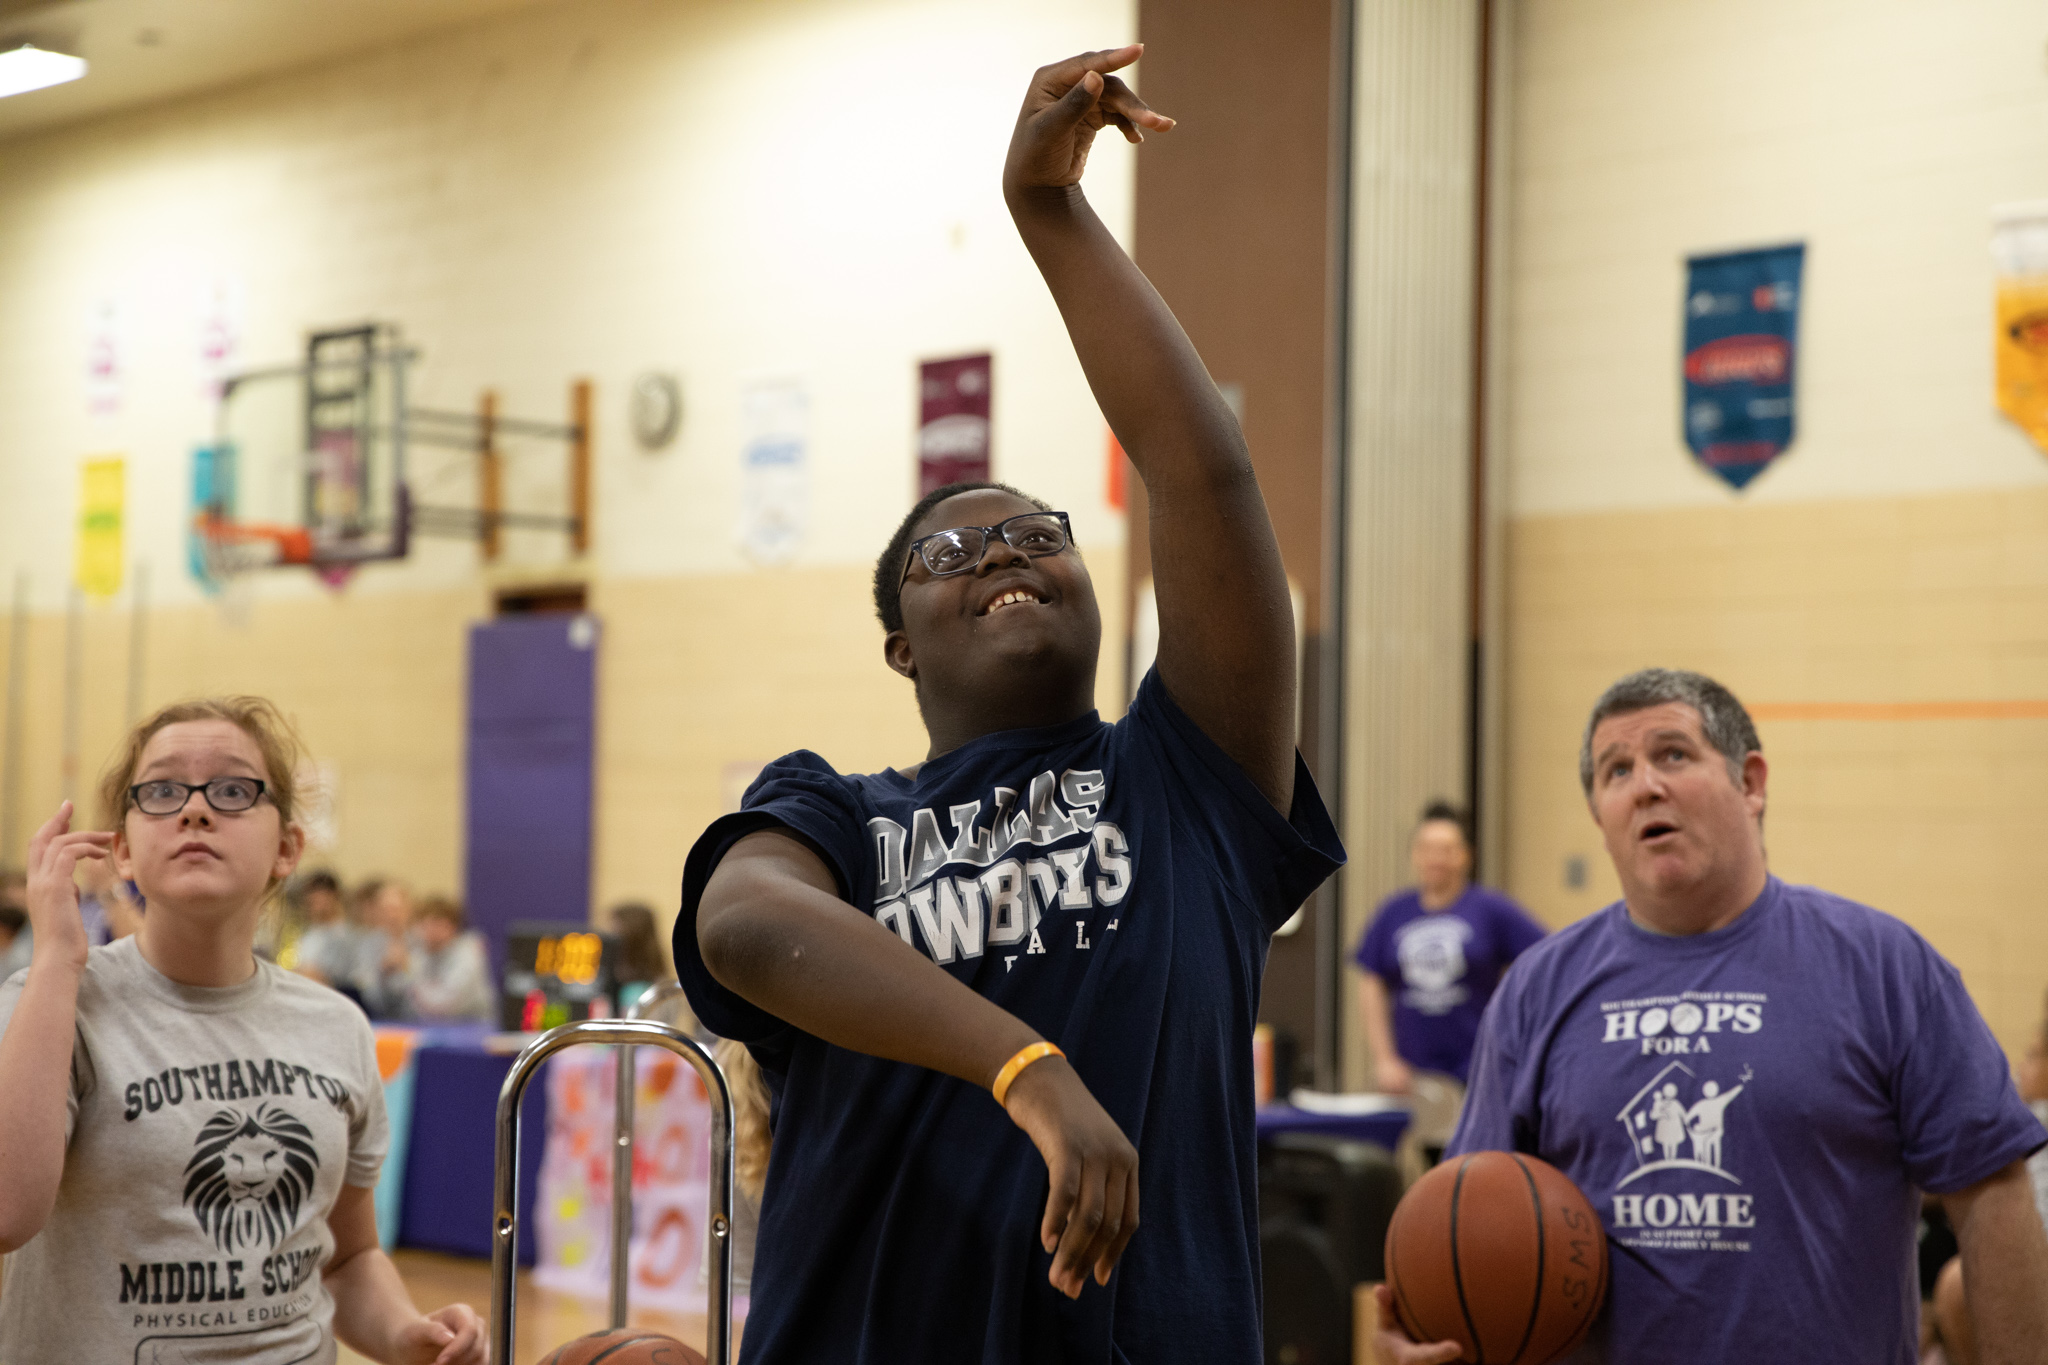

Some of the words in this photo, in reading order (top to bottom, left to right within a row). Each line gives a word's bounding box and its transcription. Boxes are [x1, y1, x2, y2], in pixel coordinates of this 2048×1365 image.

[867, 768, 1106, 904] DALLAS
[873, 821, 1133, 966] WBOYS
[1602, 1003, 1763, 1043] HOOPS
[1640, 1036, 1690, 1056] FOR
[1693, 1035, 1711, 1053] A
[124, 1058, 350, 1122] SOUTHAMPTON
[1612, 1193, 1756, 1228] HOME
[119, 1260, 246, 1304] MIDDLE
[133, 1312, 237, 1328] PHYSICAL
[247, 1293, 312, 1322] EDUCATION
